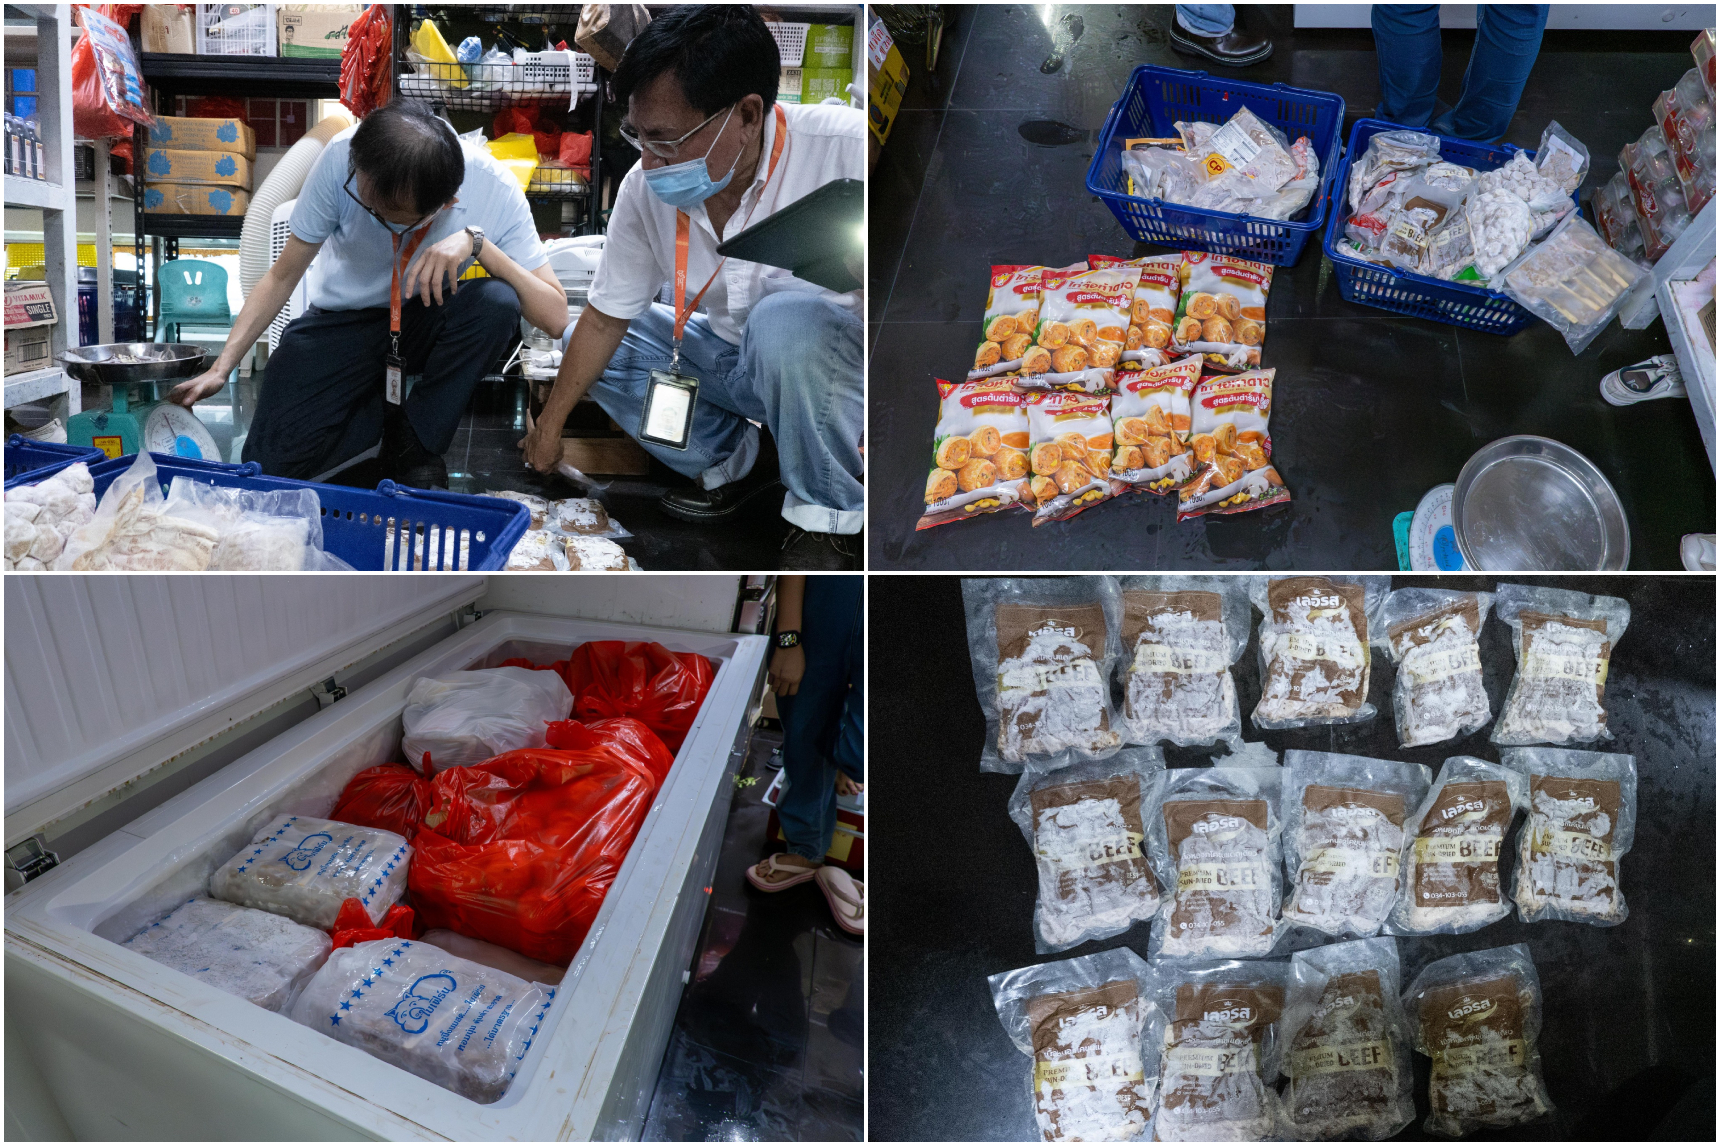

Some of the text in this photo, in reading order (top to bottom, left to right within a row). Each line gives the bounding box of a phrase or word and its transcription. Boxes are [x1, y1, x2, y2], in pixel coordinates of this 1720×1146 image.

[1209, 160, 1222, 171] CP
[26, 304, 51, 315] SINGLE
[971, 393, 1020, 406] สูตรต้นตำรับ
[1296, 595, 1340, 607] เลอรส
[1441, 800, 1484, 820] เลอรส
[1192, 817, 1239, 833] เลอรส
[1430, 891, 1468, 899] 034-103-055
[1203, 1006, 1250, 1022] เลอรส
[1448, 998, 1491, 1020] เลอรส
